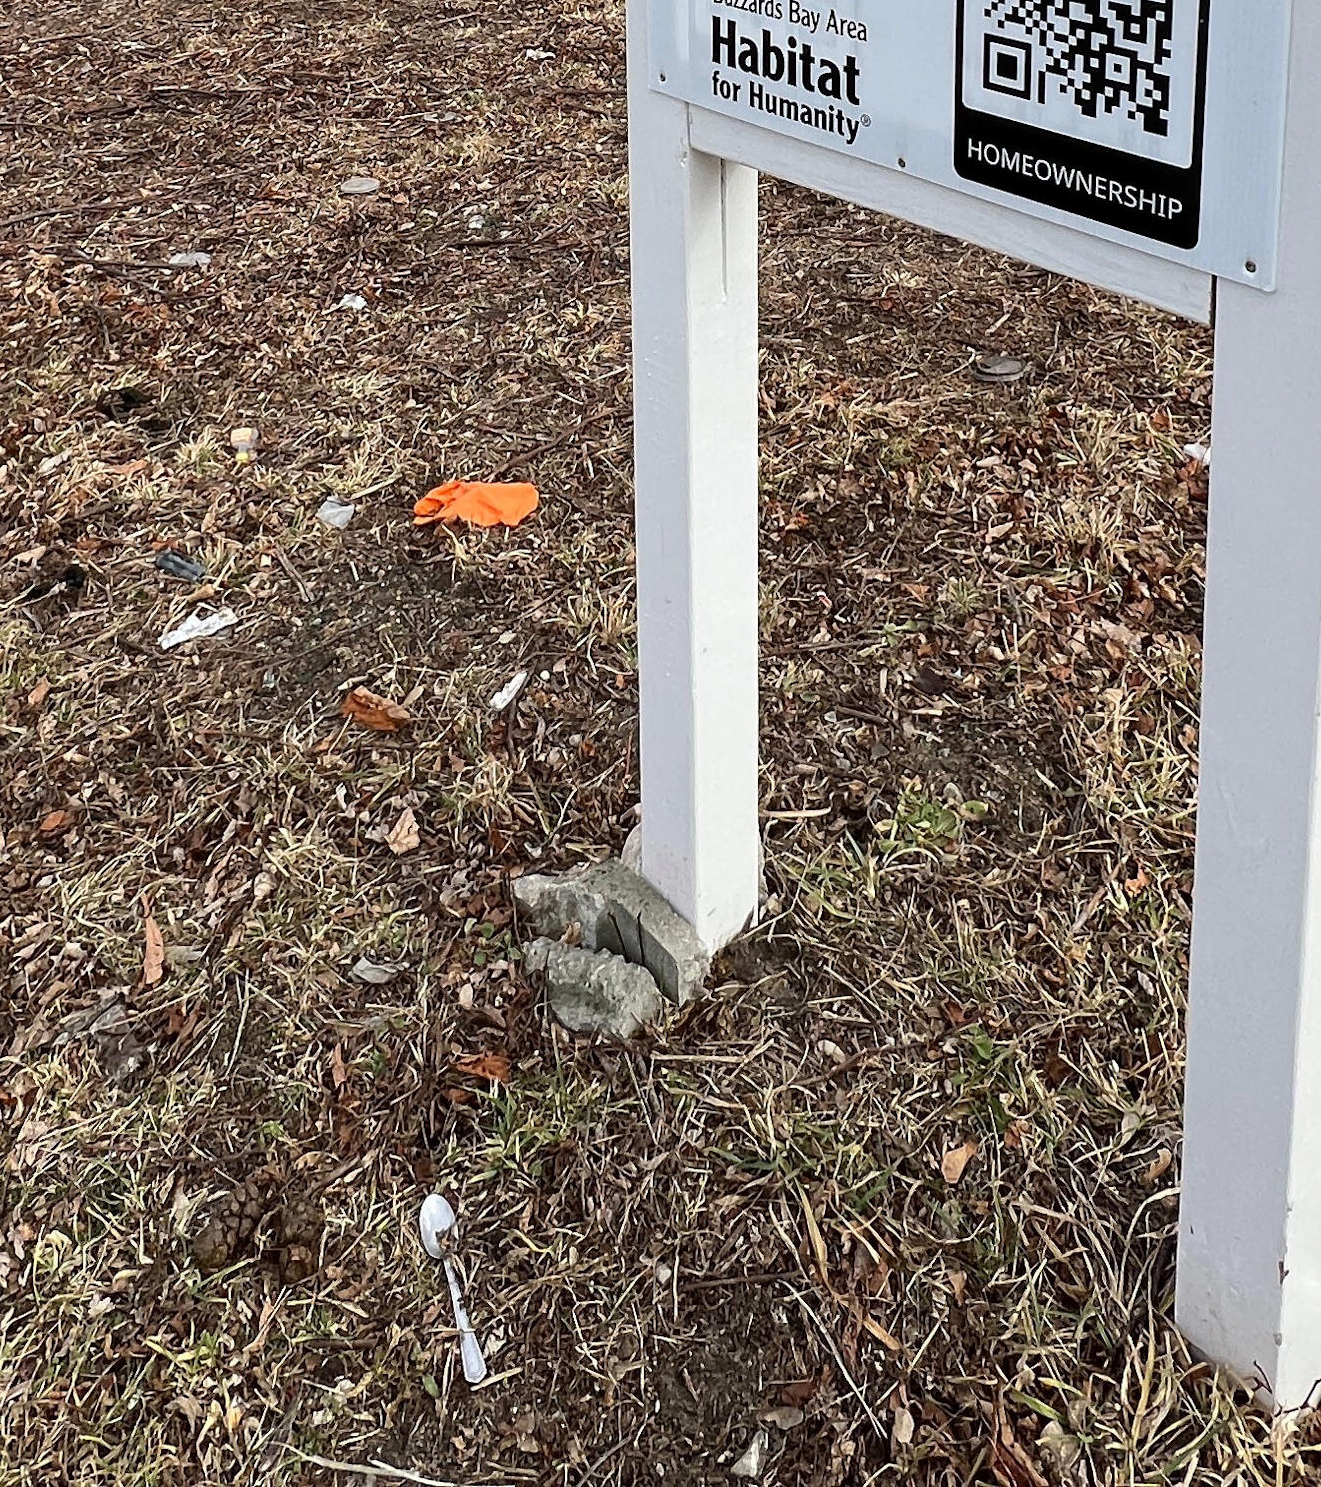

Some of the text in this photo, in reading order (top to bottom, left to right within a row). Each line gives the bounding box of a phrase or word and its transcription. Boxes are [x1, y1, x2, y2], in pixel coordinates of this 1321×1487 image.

[825, 8, 869, 43] Area
[711, 14, 862, 107] Habitat
[711, 69, 742, 103] for
[966, 136, 1184, 221] HOMEOWNERSHIP
